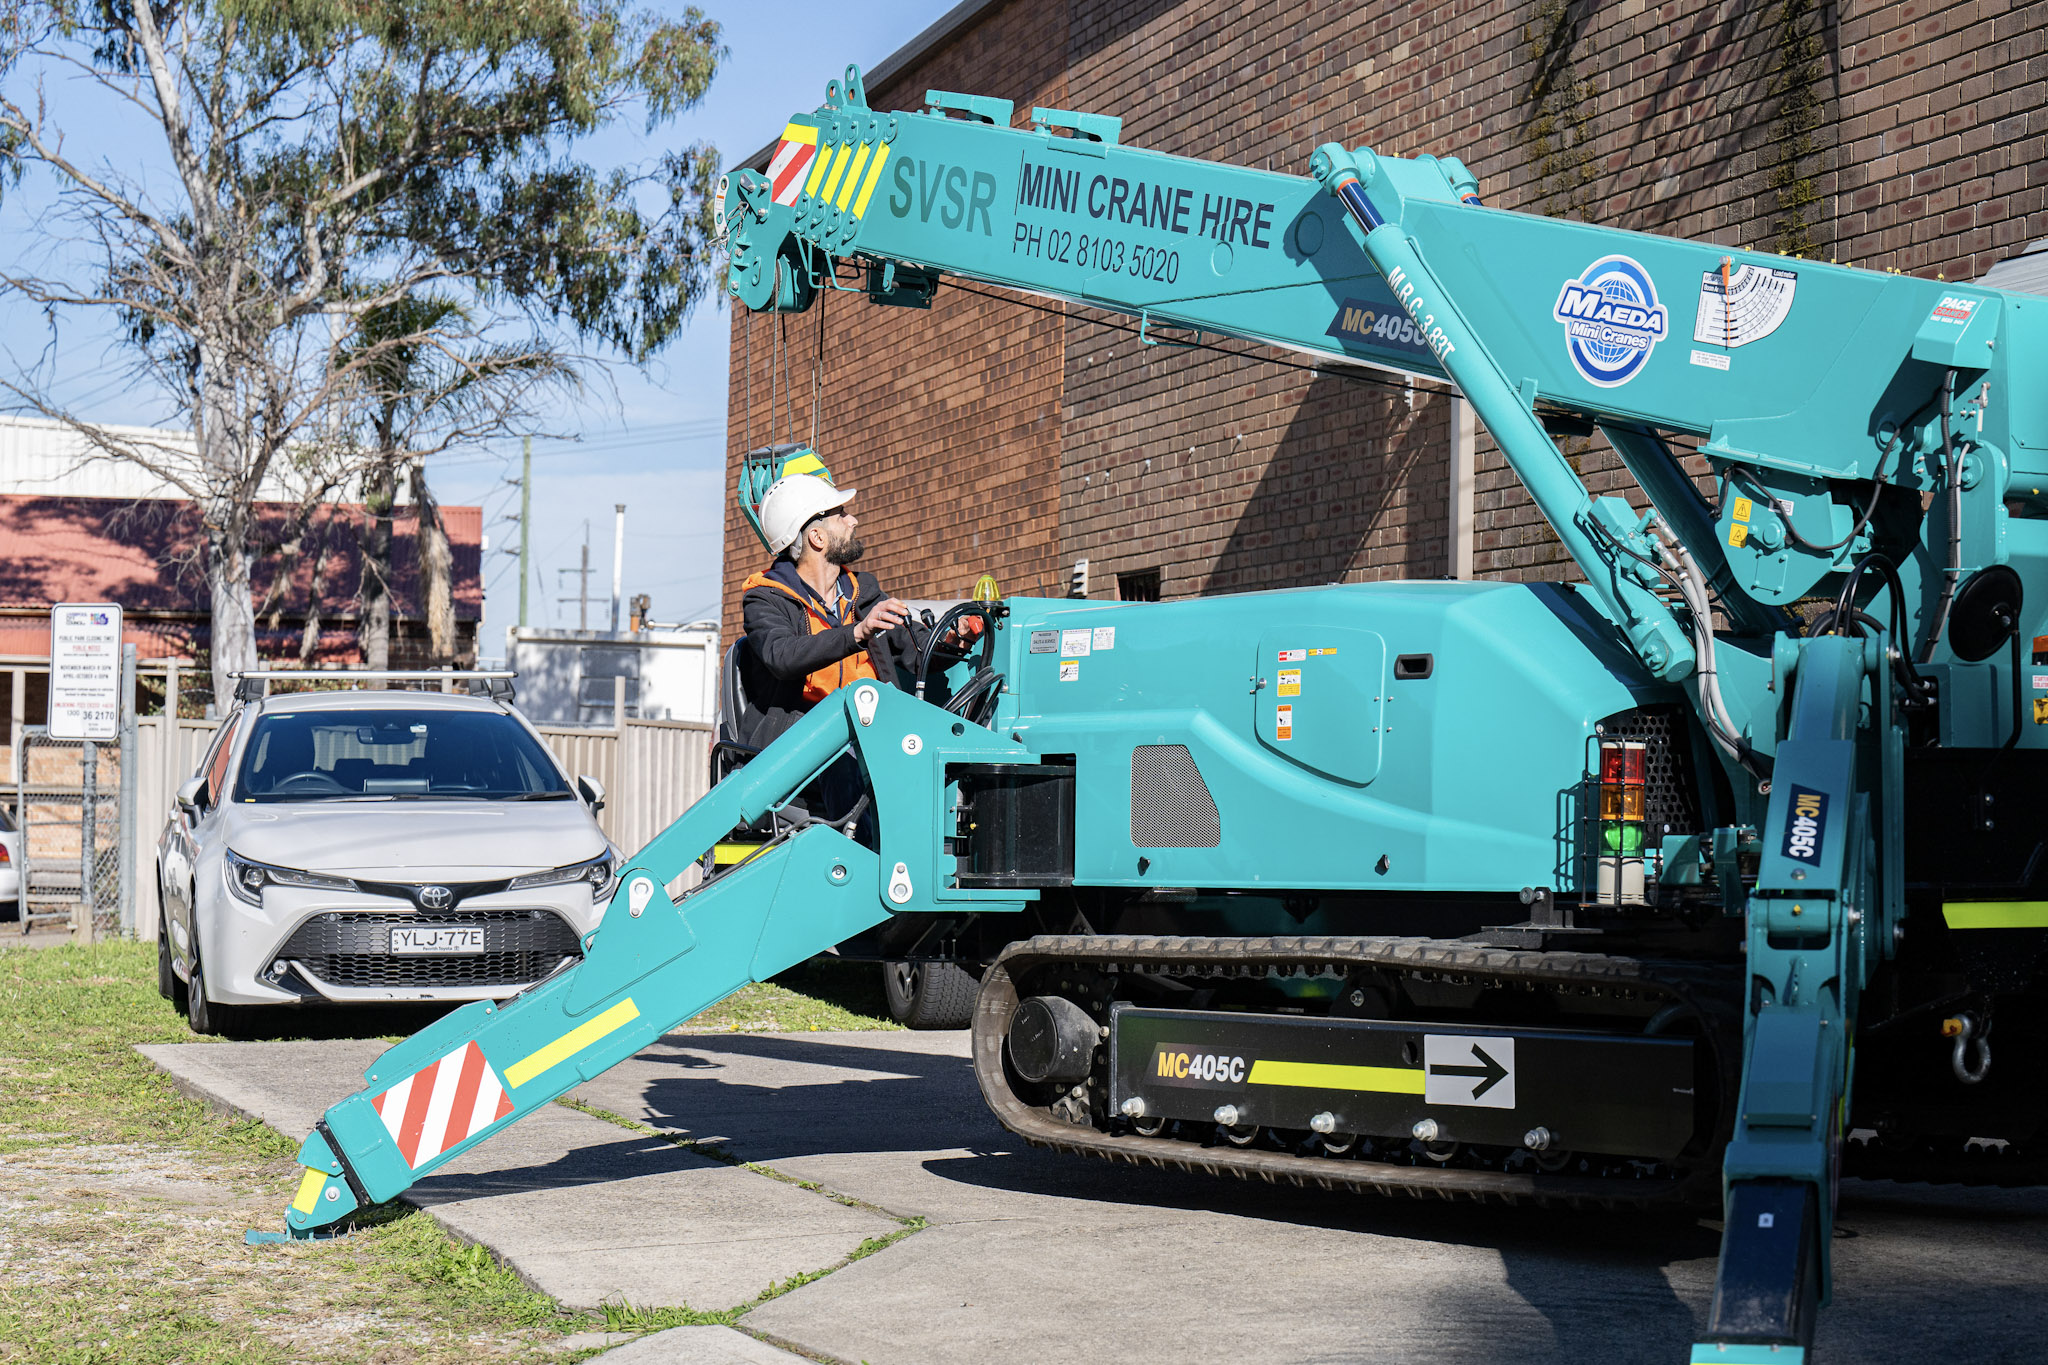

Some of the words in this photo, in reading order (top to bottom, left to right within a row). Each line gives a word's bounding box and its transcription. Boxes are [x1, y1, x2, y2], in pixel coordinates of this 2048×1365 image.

[890, 156, 997, 237] SVSR
[1019, 163, 1080, 213] MINI
[1088, 174, 1194, 234] CRANE
[1198, 193, 1274, 249] HIRE
[1013, 222, 1042, 258] PH
[1048, 229, 1069, 264] 02
[1077, 233, 1125, 273] 8103
[1129, 244, 1180, 284] 5020
[1559, 286, 1662, 334] MAEDA
[1935, 308, 1966, 318] CRANES
[1939, 297, 1977, 311] PACE
[1571, 321, 1601, 339] Mini
[1601, 327, 1648, 349] Cranes
[83, 711, 93, 721] 36
[95, 711, 115, 721] 2170
[907, 739, 917, 750] 3
[1788, 794, 1822, 858] MC405C
[1157, 1052, 1246, 1083] MC405C
